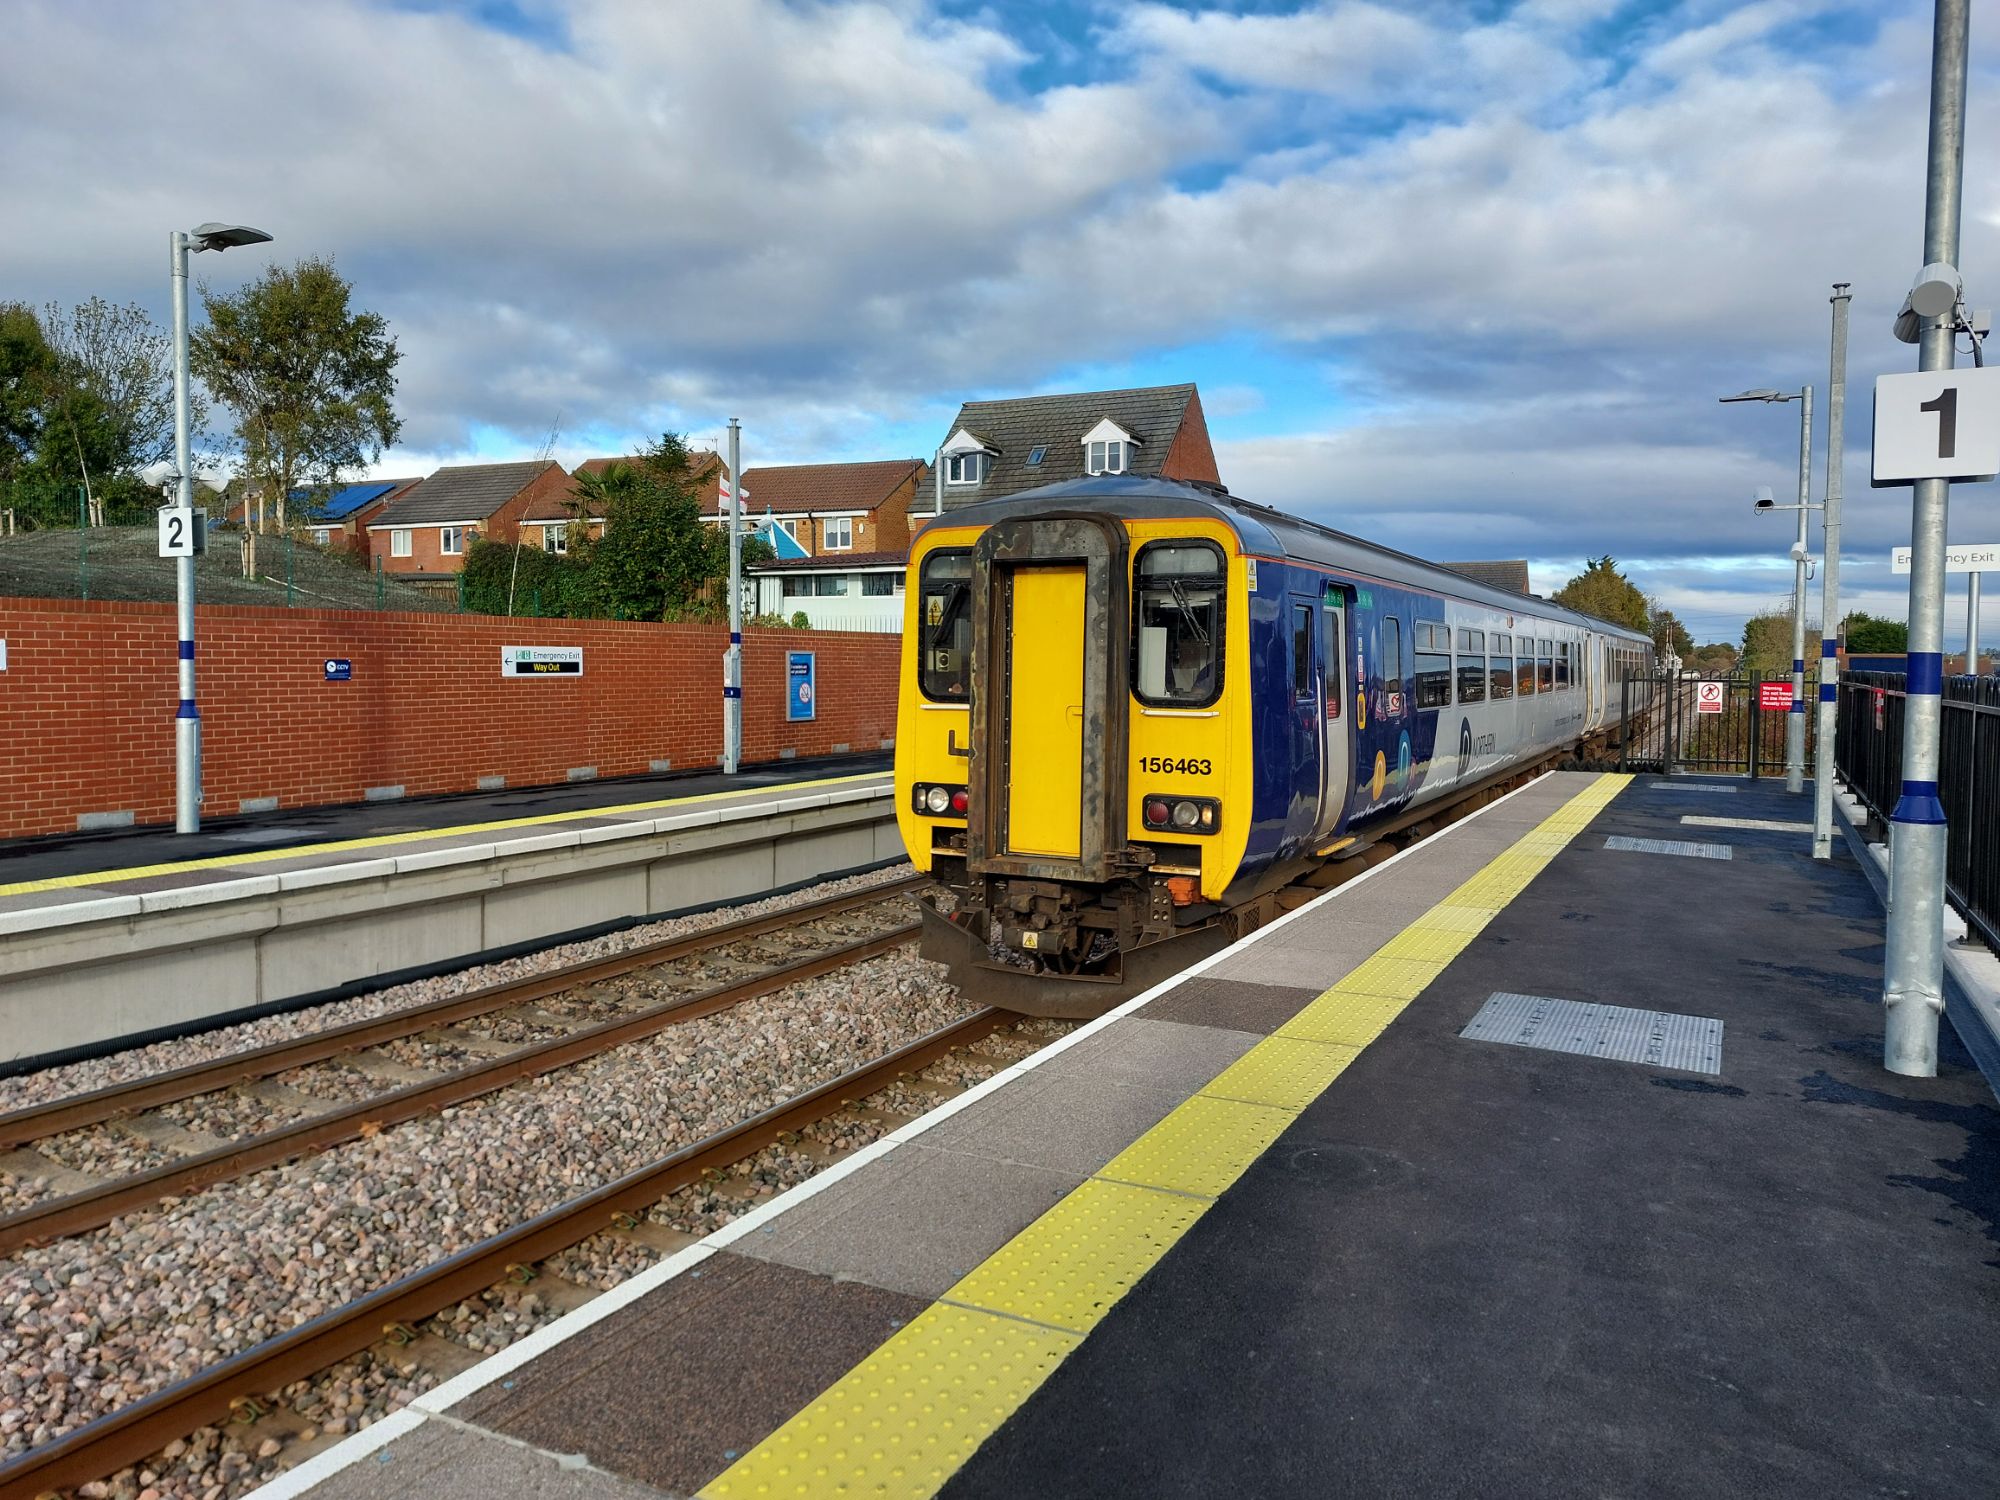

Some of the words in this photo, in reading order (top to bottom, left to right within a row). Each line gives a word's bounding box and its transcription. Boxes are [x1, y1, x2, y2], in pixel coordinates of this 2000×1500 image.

[1920, 388, 1957, 458] 1
[168, 516, 183, 548] 2
[1971, 552, 1995, 562] Exit
[533, 651, 567, 660] Emergency
[568, 652, 580, 660] Exit
[533, 663, 547, 672] Way
[548, 663, 560, 671] Out
[1473, 733, 1496, 758] NORTHERN
[1139, 757, 1212, 775] 156463
